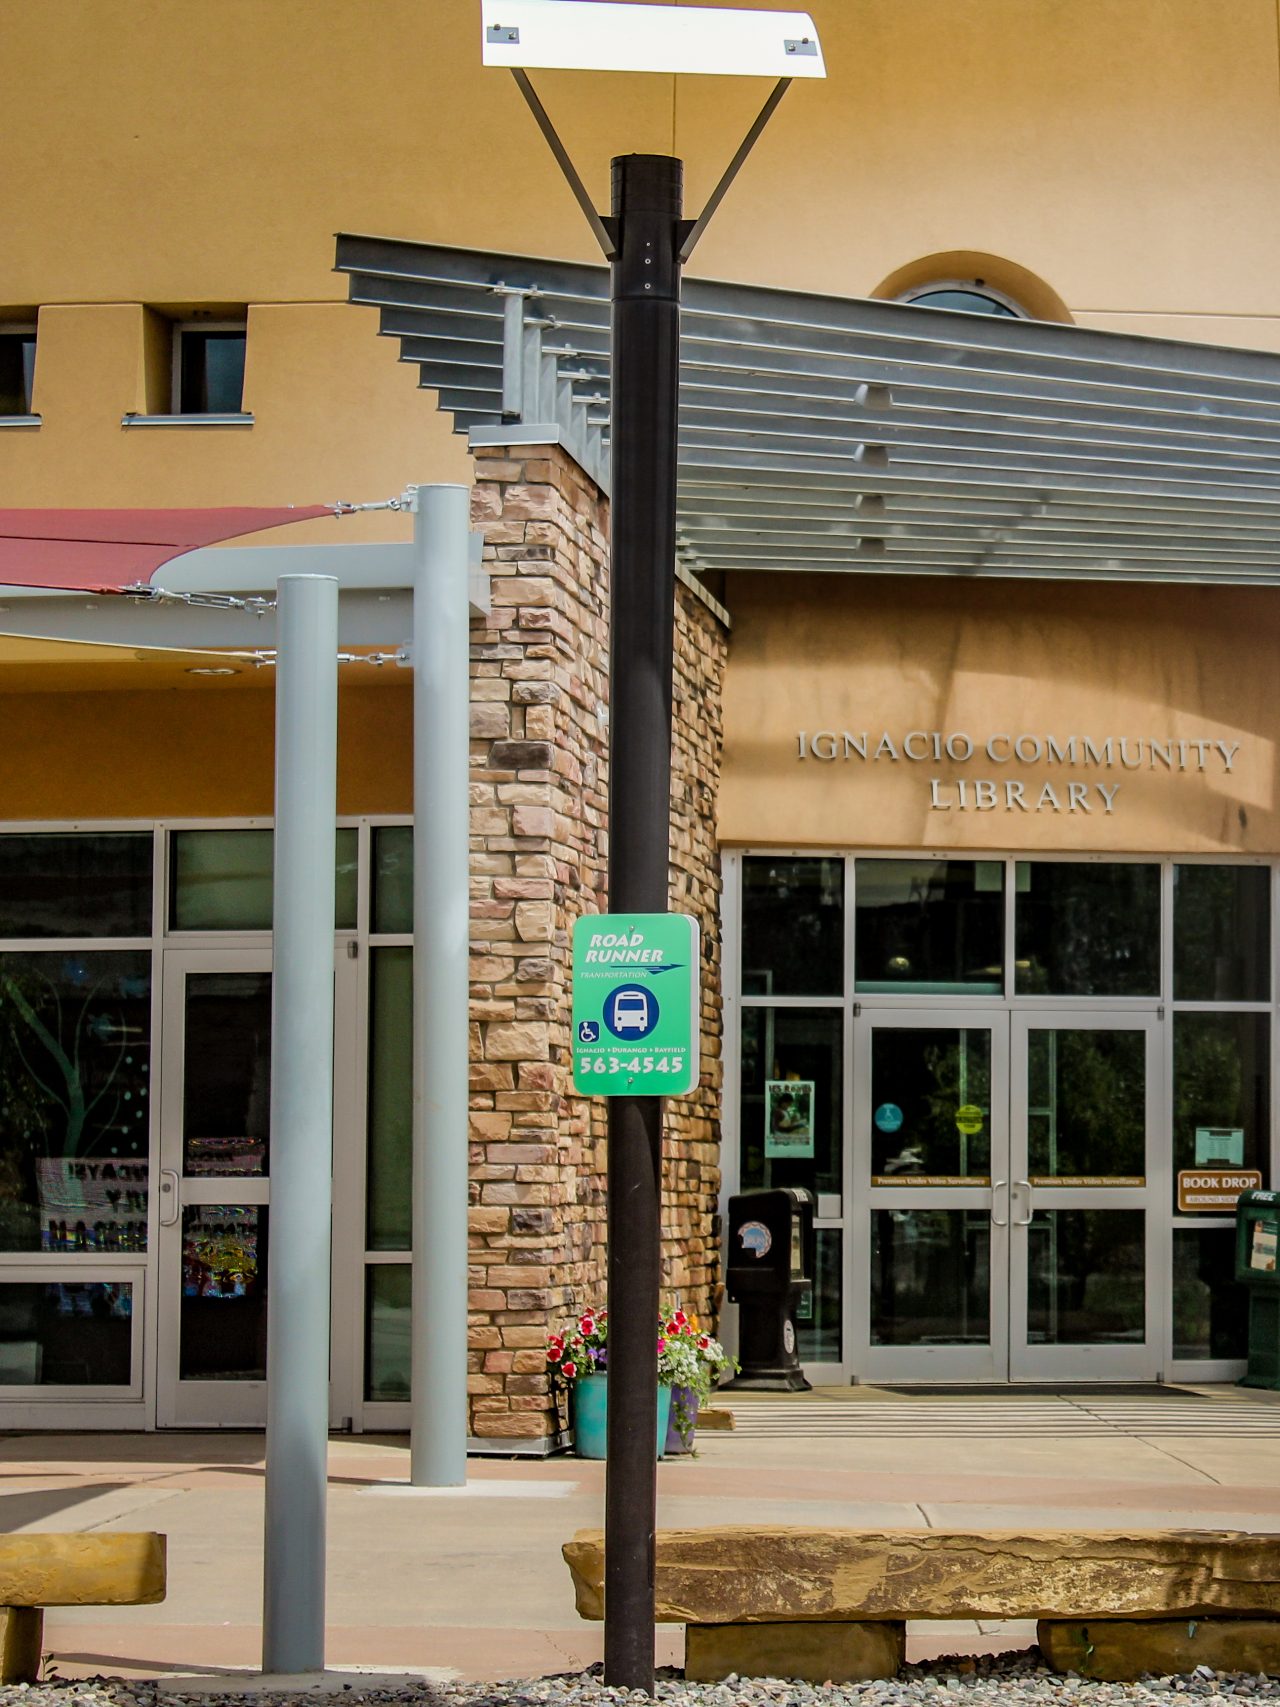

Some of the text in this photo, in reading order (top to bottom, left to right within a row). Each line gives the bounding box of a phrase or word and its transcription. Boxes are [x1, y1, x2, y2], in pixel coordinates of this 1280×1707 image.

[797, 731, 1242, 772] IGNACIO COMMUNITY
[929, 779, 1121, 815] LIBRARY
[590, 934, 644, 948] ROAD
[585, 949, 664, 964] RUNNER
[580, 971, 648, 979] TRANSPORTATION
[580, 1057, 683, 1074] 563-4545
[1183, 1177, 1257, 1189] BOOK DROP
[1251, 1191, 1277, 1202] FREE
